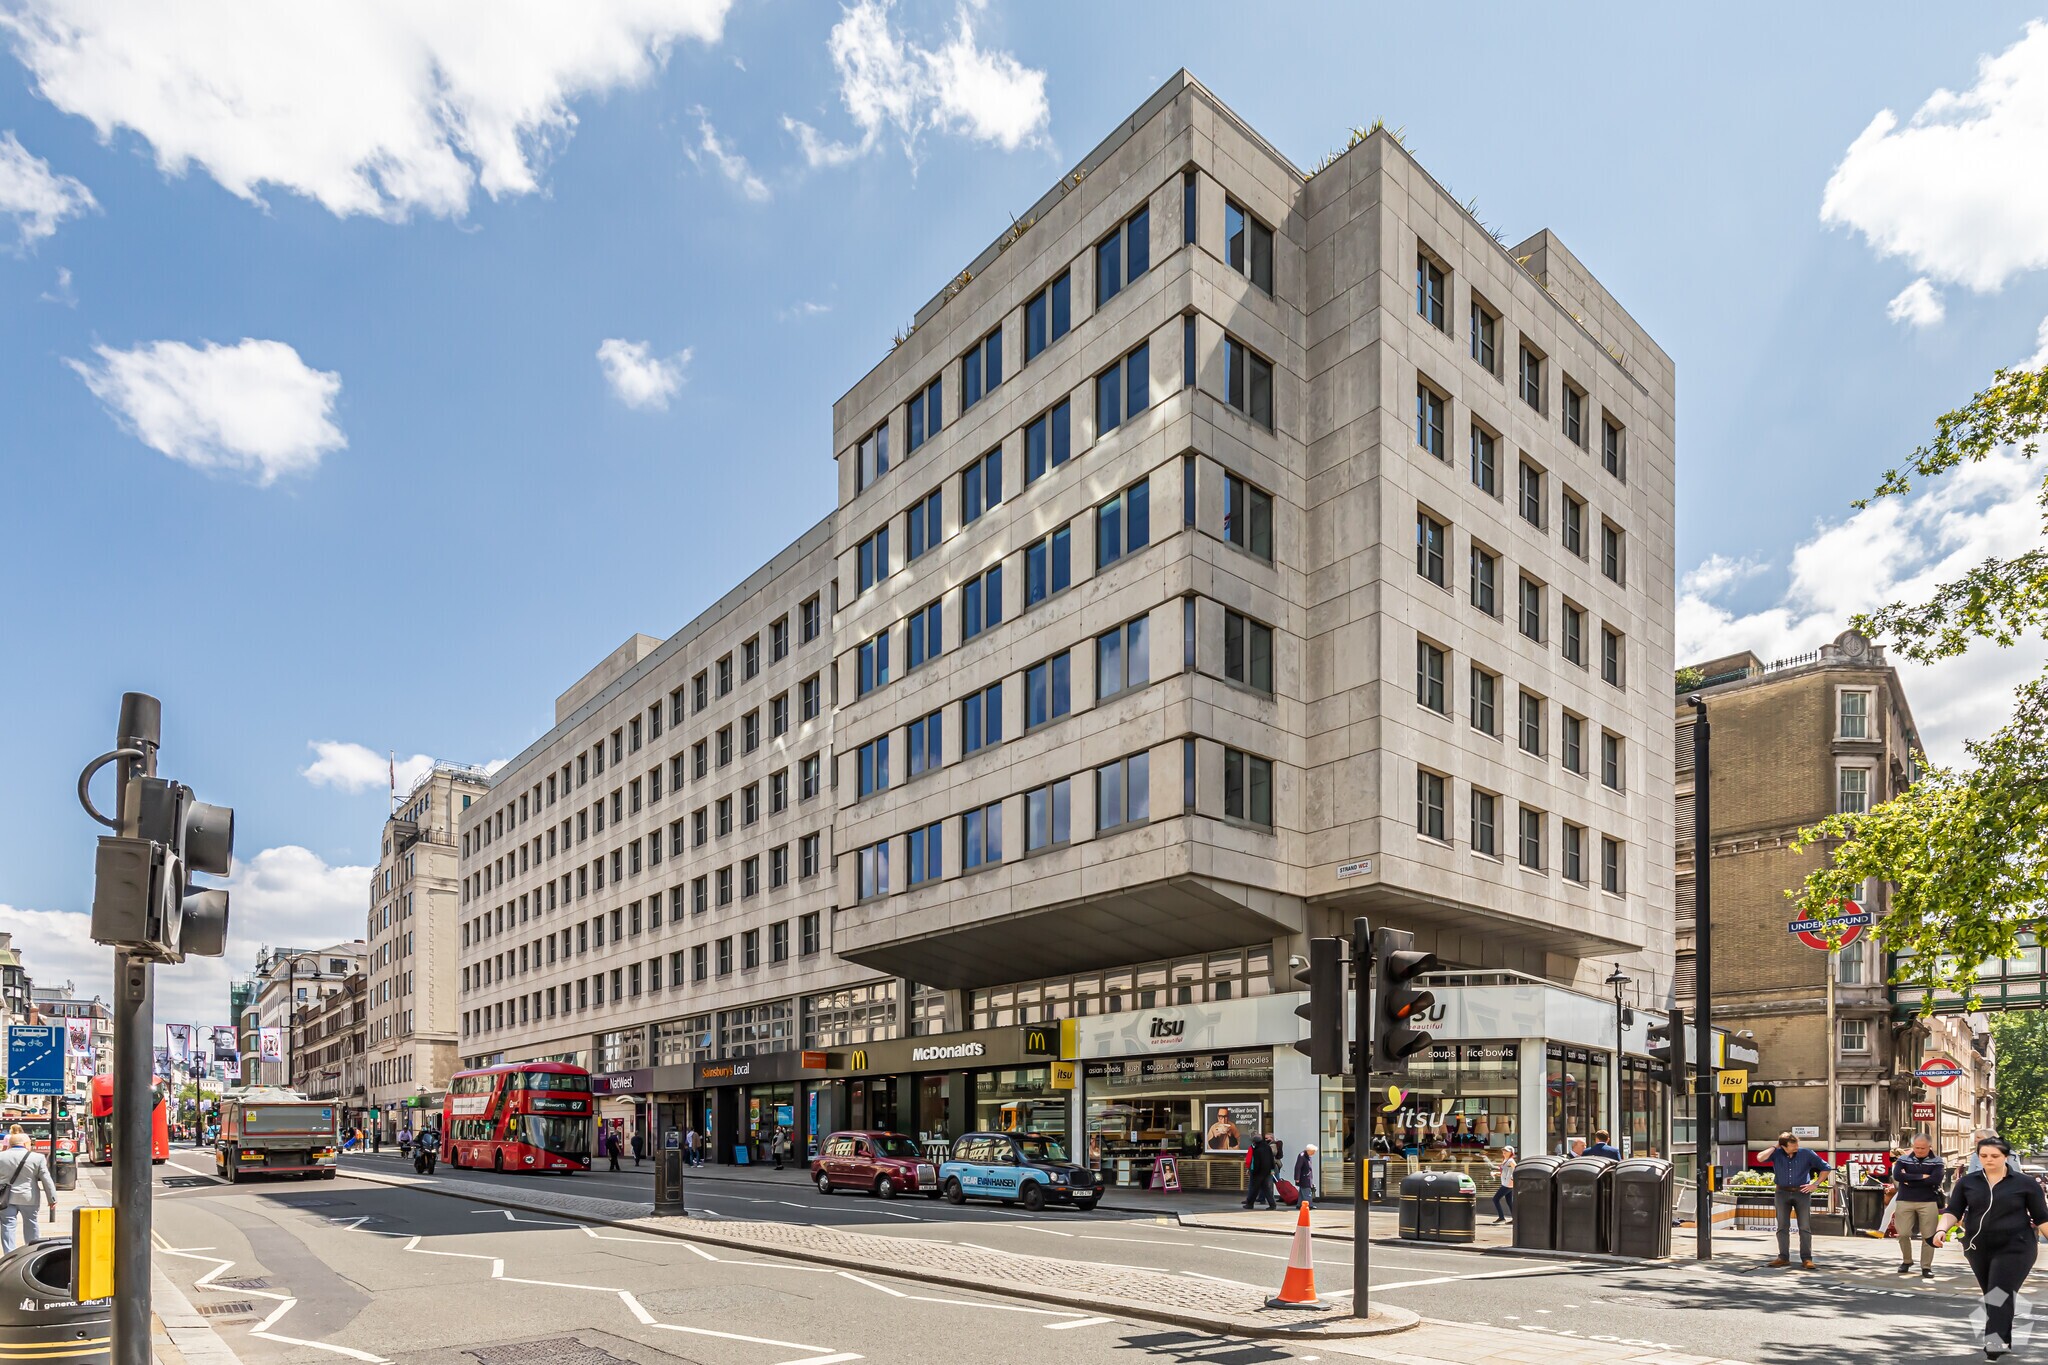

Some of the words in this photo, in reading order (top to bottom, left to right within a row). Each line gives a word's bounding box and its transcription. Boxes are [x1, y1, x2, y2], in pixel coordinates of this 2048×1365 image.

[1340, 864, 1357, 873] STRAND
[1791, 915, 1869, 931] UNDERGROUND
[1412, 1004, 1446, 1022] su
[1150, 1017, 1185, 1038] itsu
[913, 1042, 985, 1062] McDonald's
[1428, 1050, 1456, 1060] soups
[1231, 1057, 1242, 1066] hot
[1243, 1055, 1270, 1064] noodles
[702, 1065, 734, 1079] Sainsbury's
[734, 1062, 750, 1075] Local
[1057, 1069, 1073, 1080] itsu
[609, 1076, 633, 1090] NatWest
[1723, 1076, 1743, 1085] itsu
[571, 1101, 583, 1110] 87
[1397, 1106, 1445, 1129] itsu
[1850, 1153, 1883, 1163] FIVE
[962, 1175, 978, 1184] DEAR
[977, 1177, 992, 1186] EVAN
[992, 1178, 1016, 1187] HANSEN
